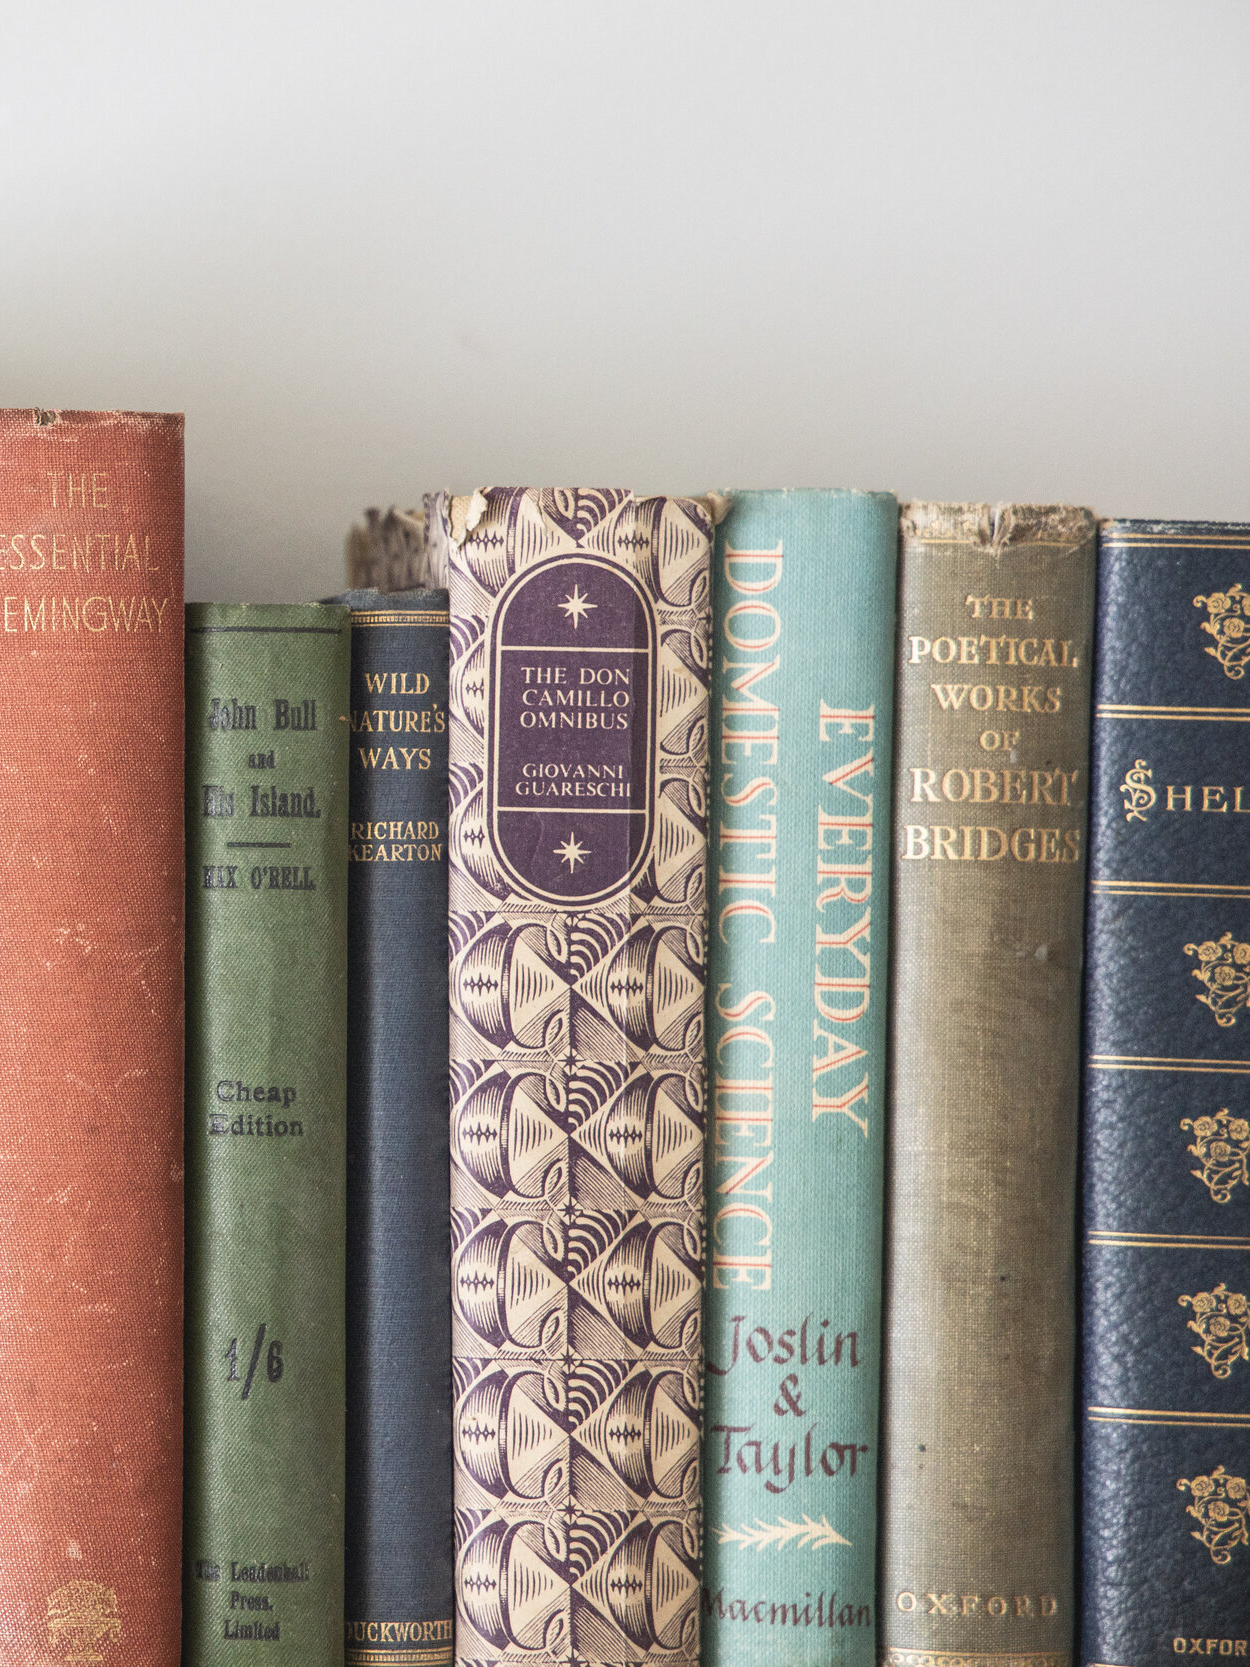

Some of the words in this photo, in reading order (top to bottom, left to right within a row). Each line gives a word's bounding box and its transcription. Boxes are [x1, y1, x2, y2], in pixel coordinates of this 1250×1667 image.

[47, 472, 108, 508] THE
[965, 593, 1035, 620] THE
[908, 634, 1079, 669] POETICAL
[365, 672, 430, 695] WILD
[521, 666, 567, 685] THE
[579, 667, 630, 685] DON
[522, 688, 630, 708] CAMILLO
[930, 683, 1063, 713] WORKS
[208, 698, 258, 732] John
[273, 699, 318, 731] Bull
[350, 703, 446, 733] NATURE'S
[519, 710, 629, 730] OMNIBUS
[718, 539, 784, 945] DOMESTIC
[979, 729, 1021, 751] OF
[248, 750, 277, 770] and
[359, 746, 431, 770] WAYS
[522, 763, 624, 779] GIOVANNI
[249, 785, 322, 818] Island.
[515, 781, 632, 798] GUARESCHI
[909, 767, 1080, 806] ROBERT
[351, 820, 440, 841] RICHARD
[901, 824, 1082, 863] BRIDGES
[348, 843, 443, 862] KEARTON
[812, 698, 875, 1139] EVERYDAY
[216, 1080, 297, 1109] Cheap
[208, 1113, 305, 1137] Edition
[712, 983, 777, 1291] SCIENCE
[706, 1311, 863, 1376] Joslin
[224, 1323, 285, 1401] 1/6
[772, 1372, 808, 1417] &
[710, 1421, 869, 1494] Taylor
[702, 1586, 871, 1628] Macmillan
[896, 1590, 1058, 1616] OXFORD
